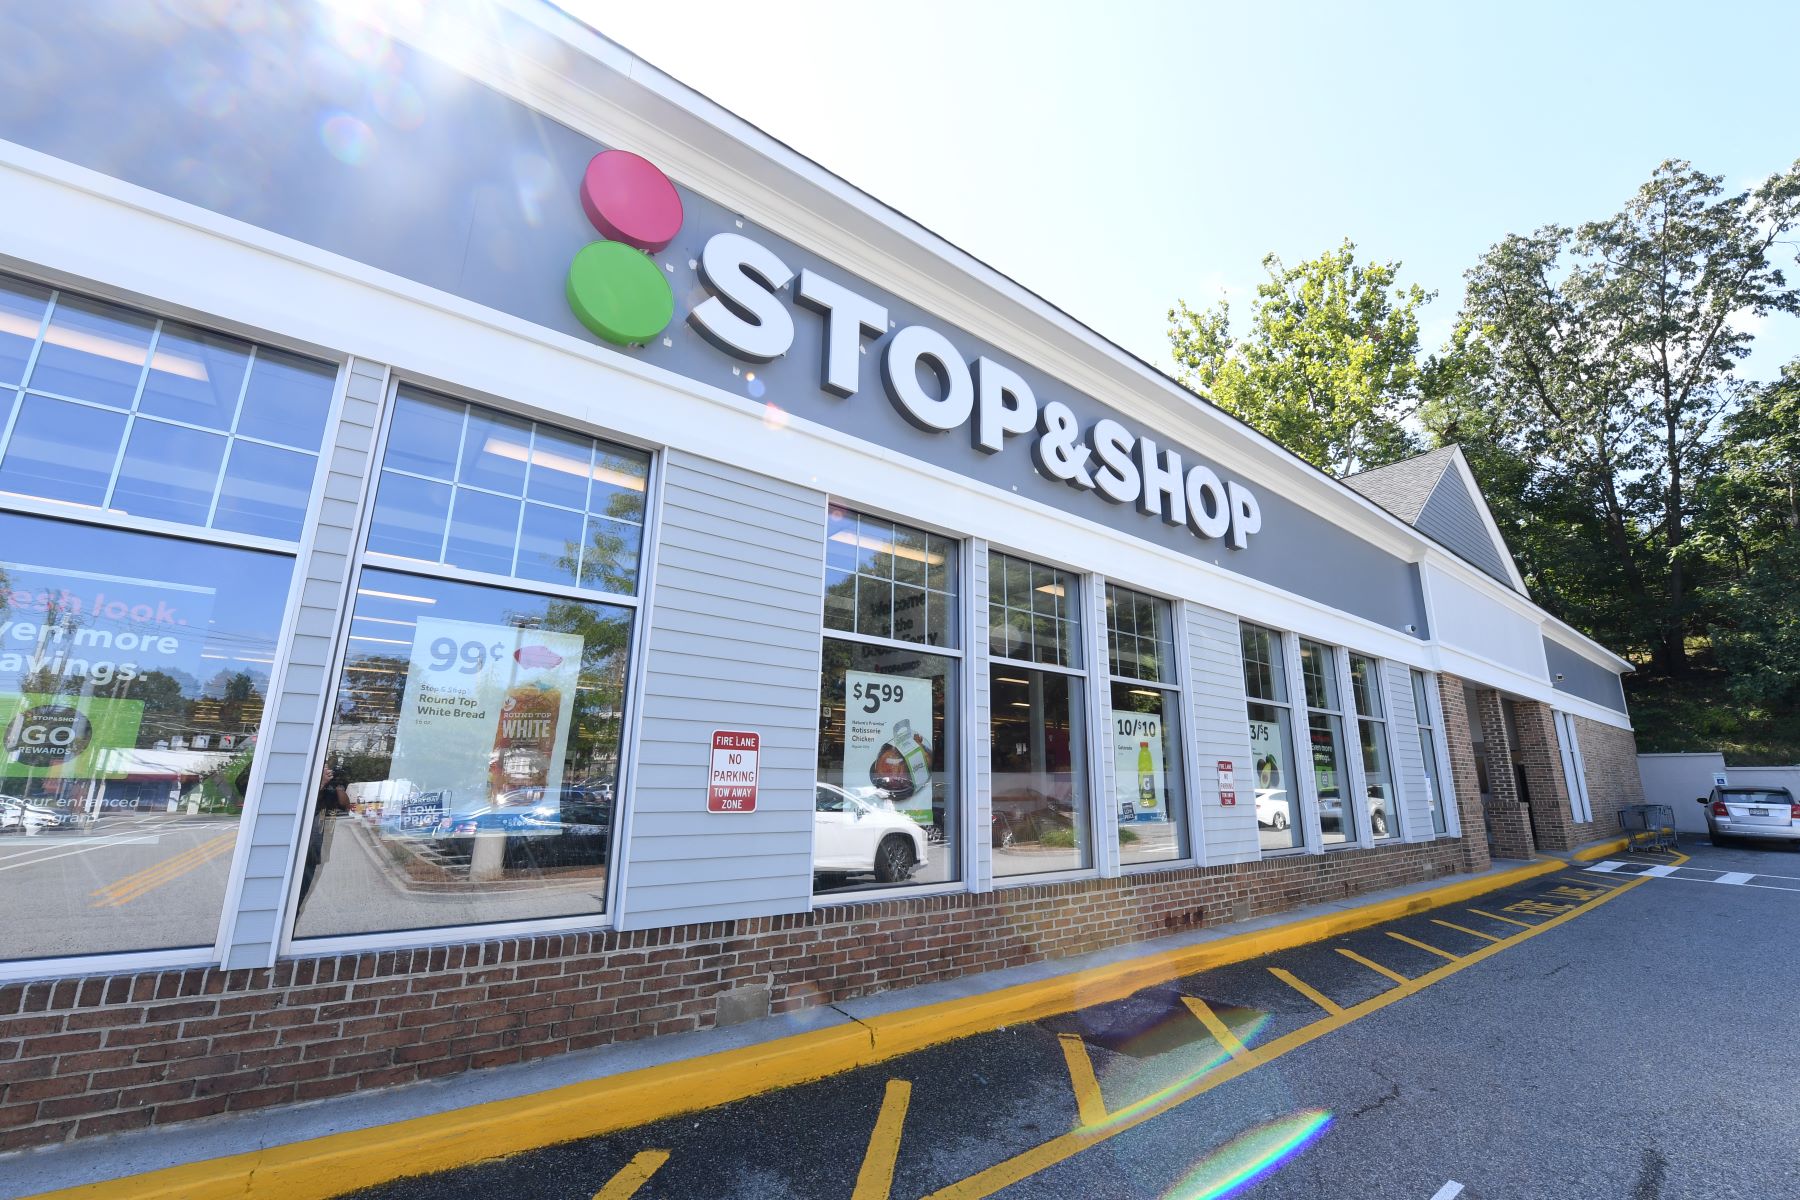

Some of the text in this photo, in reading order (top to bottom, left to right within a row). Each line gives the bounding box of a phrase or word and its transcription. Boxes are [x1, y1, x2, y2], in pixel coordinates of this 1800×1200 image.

[93, 593, 188, 625] look.
[74, 627, 179, 654] more
[428, 637, 505, 675] 99¢
[419, 694, 478, 708] Round Top
[417, 706, 486, 720] White Bread
[502, 720, 550, 738] WHITE
[852, 726, 881, 735] Rotisserie
[22, 725, 76, 746] GO
[716, 736, 756, 747] FIRE LANE
[18, 746, 72, 756] REWARDS
[728, 754, 742, 764] NO
[713, 770, 754, 782] PARKING
[714, 788, 752, 798] TOW AWAY
[408, 805, 436, 816] LOW
[722, 800, 742, 809] ZONE
[404, 814, 440, 826] PRICE
